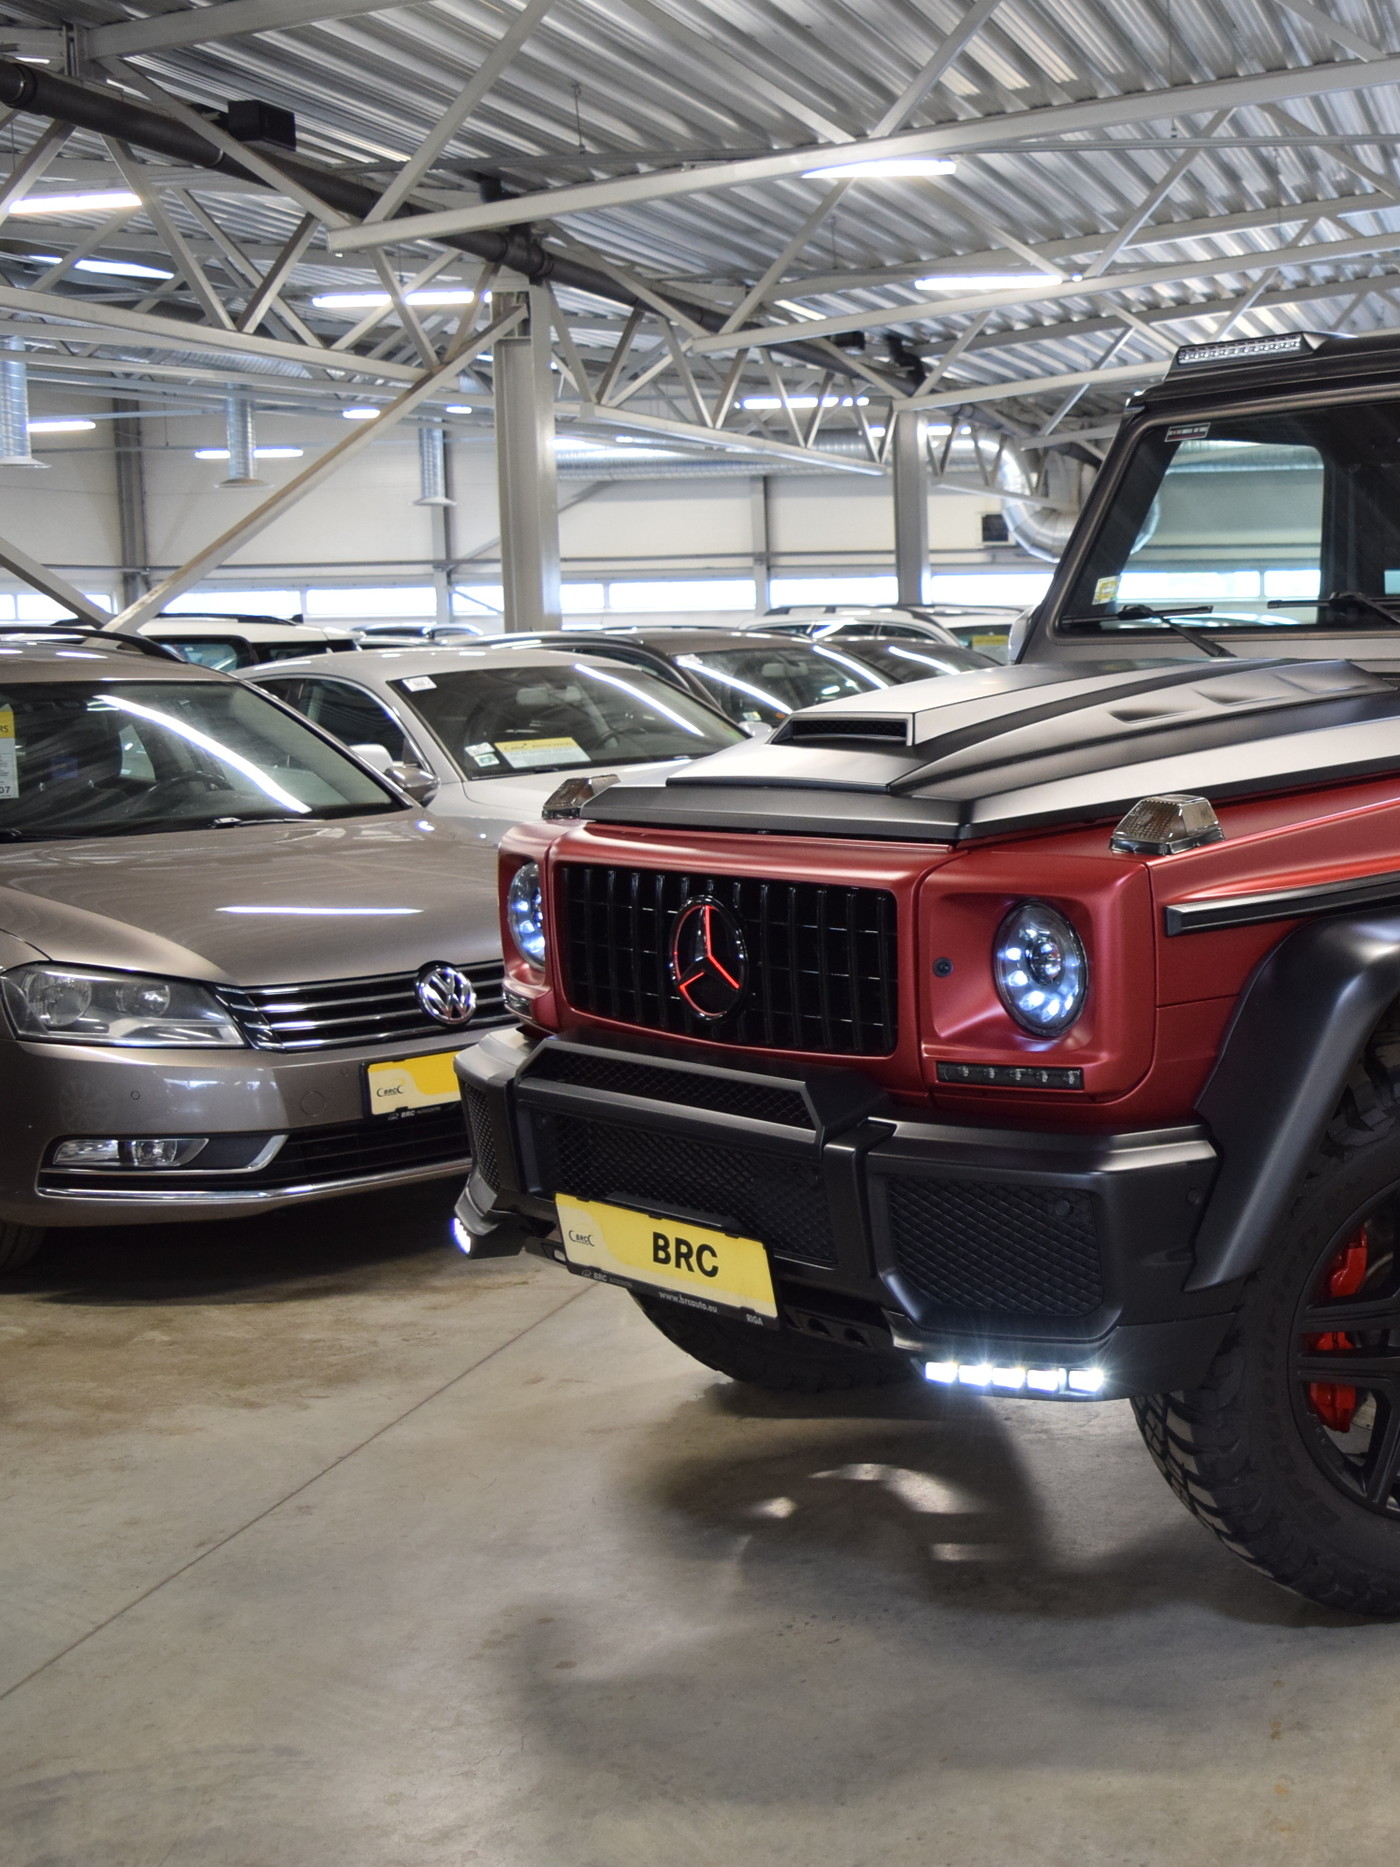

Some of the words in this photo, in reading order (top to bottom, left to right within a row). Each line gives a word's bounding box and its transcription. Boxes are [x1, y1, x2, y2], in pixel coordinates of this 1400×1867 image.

[652, 1231, 720, 1279] BRC
[658, 1291, 718, 1313] www.brcauto.eu
[745, 1313, 764, 1326] RIGA
